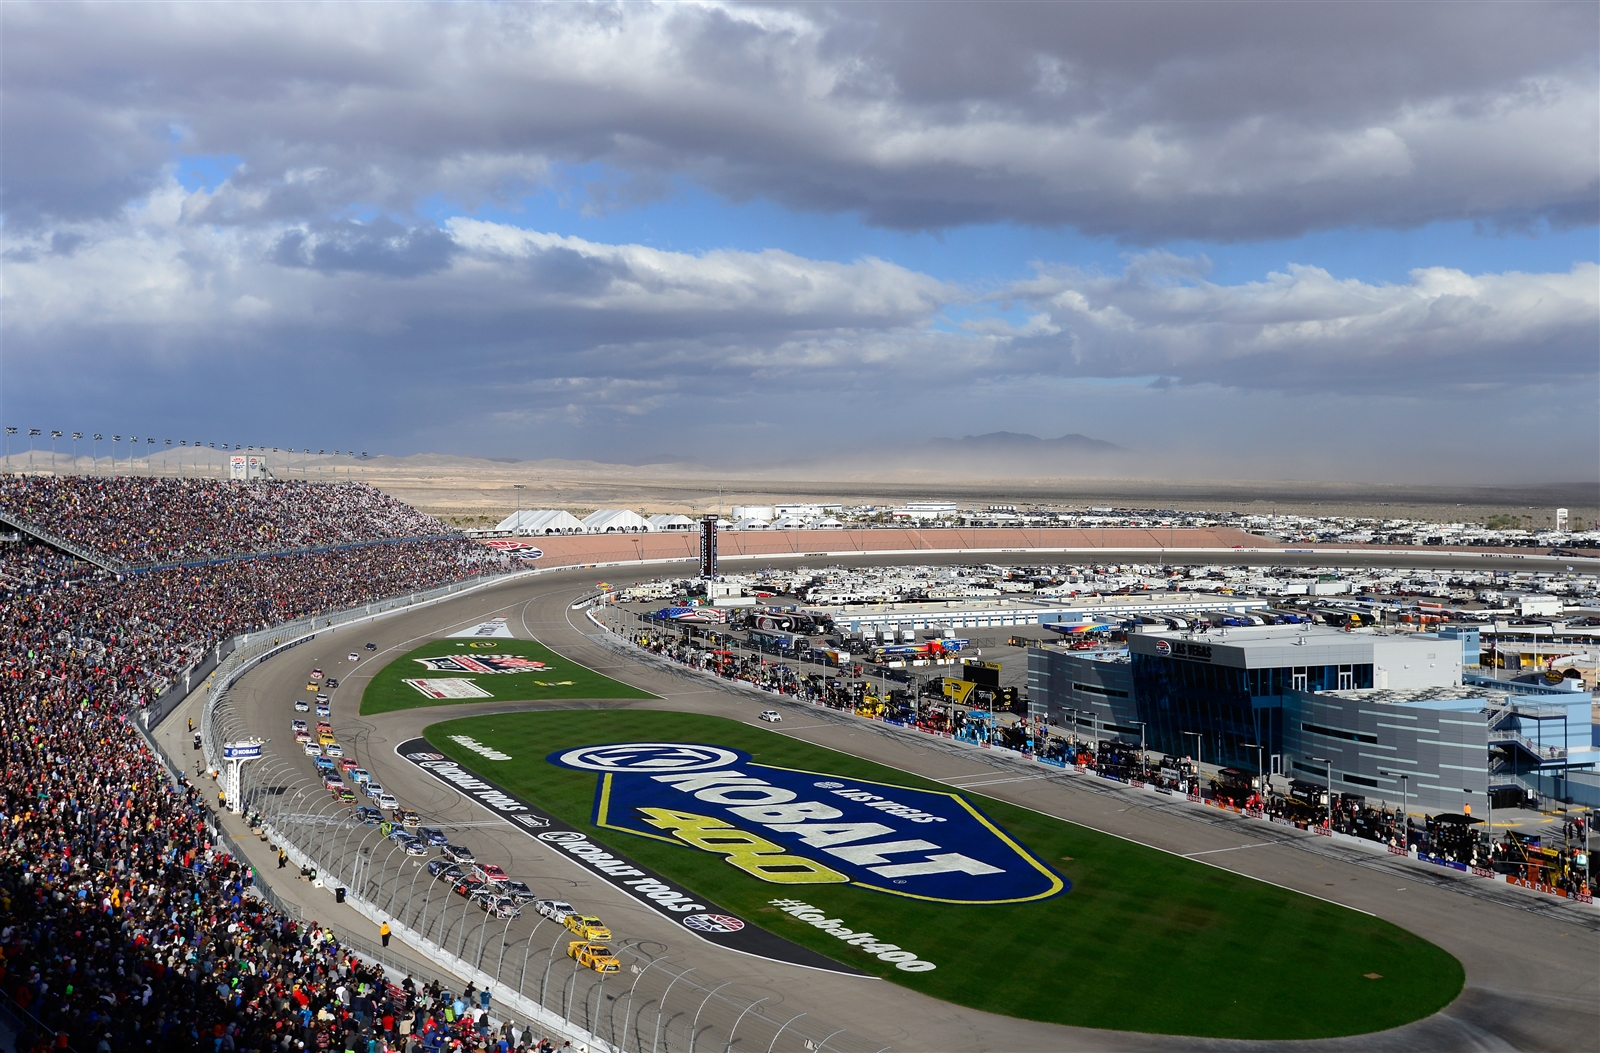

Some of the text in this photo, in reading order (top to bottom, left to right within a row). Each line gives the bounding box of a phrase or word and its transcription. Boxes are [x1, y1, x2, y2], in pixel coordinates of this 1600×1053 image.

[1172, 642, 1186, 654] LAS
[1187, 644, 1212, 658] VEGAS
[432, 767, 528, 811] KOBALT TOOLS
[830, 789, 947, 823] LAS VEGAS
[637, 807, 850, 884] 400
[650, 770, 1006, 878] KOBALT
[557, 841, 707, 912] KOBALT TOOLS
[1513, 879, 1557, 895] ARRIS
[767, 898, 937, 972] #Kobalt400
